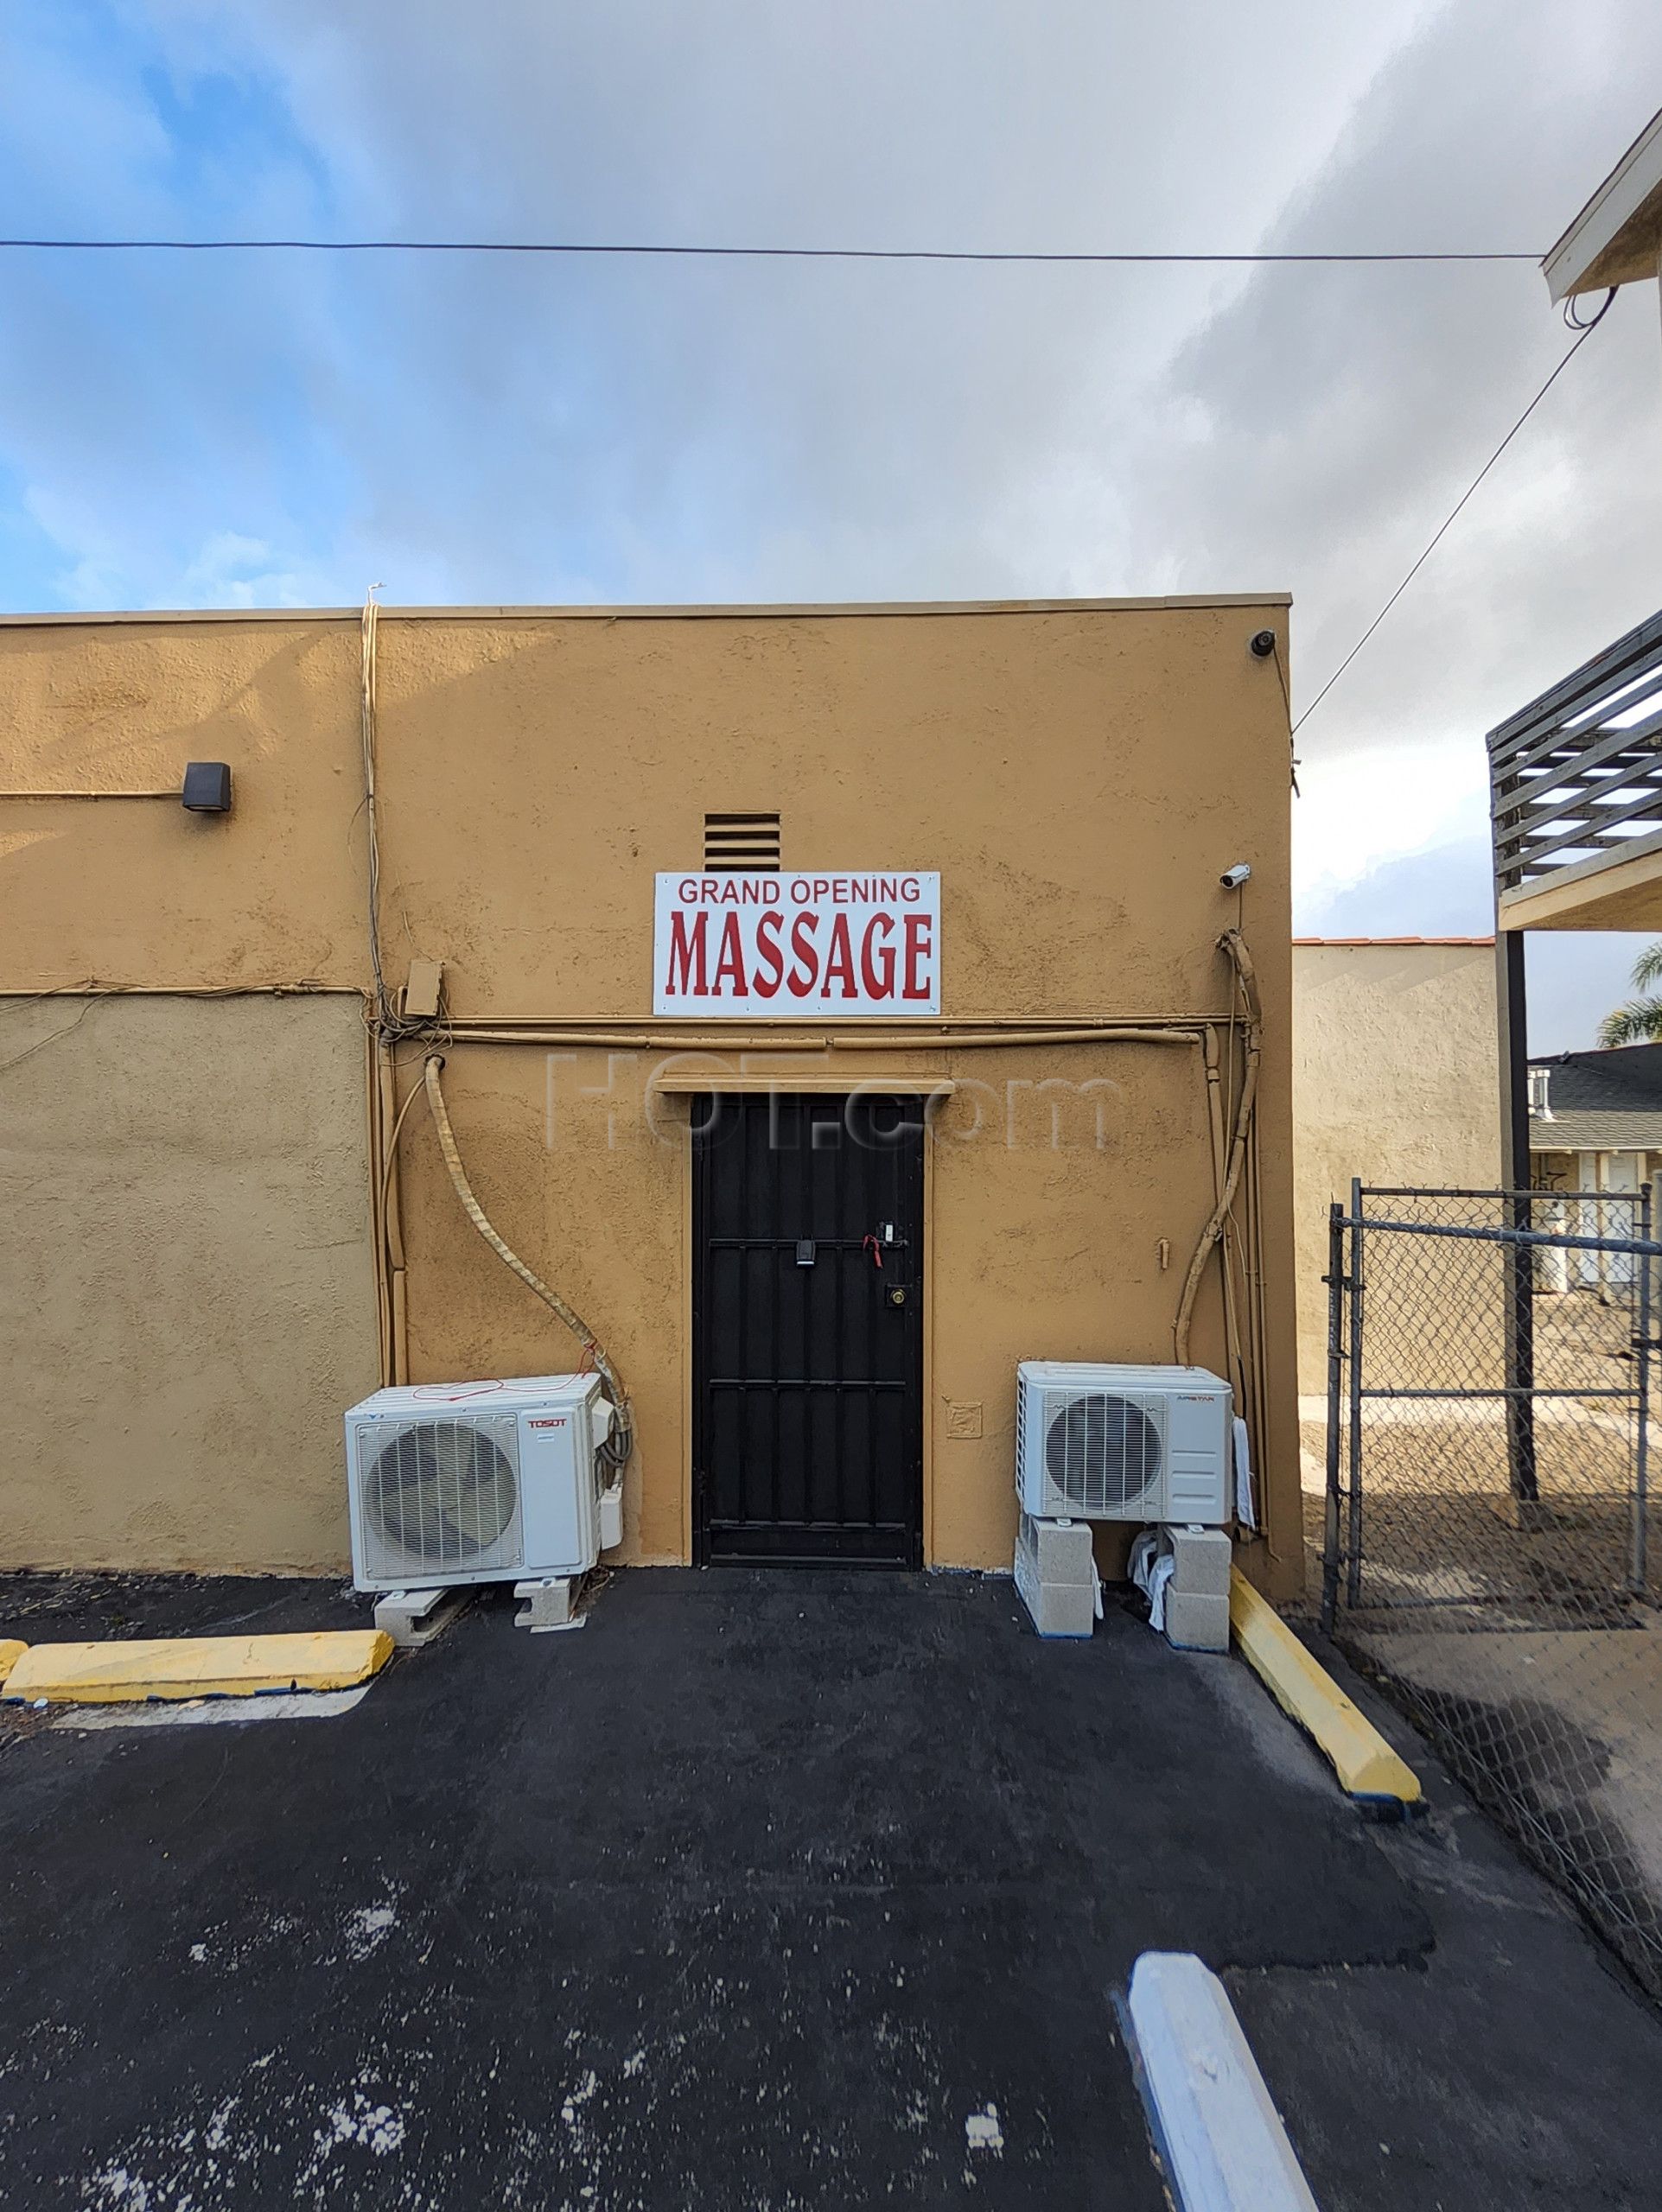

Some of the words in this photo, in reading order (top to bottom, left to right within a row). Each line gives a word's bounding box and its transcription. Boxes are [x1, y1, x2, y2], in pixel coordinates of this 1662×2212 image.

[678, 879, 780, 905] GRAND
[790, 877, 920, 904] OPENING
[665, 910, 933, 1001] MASSAGE
[528, 1419, 567, 1428] TOSOT
